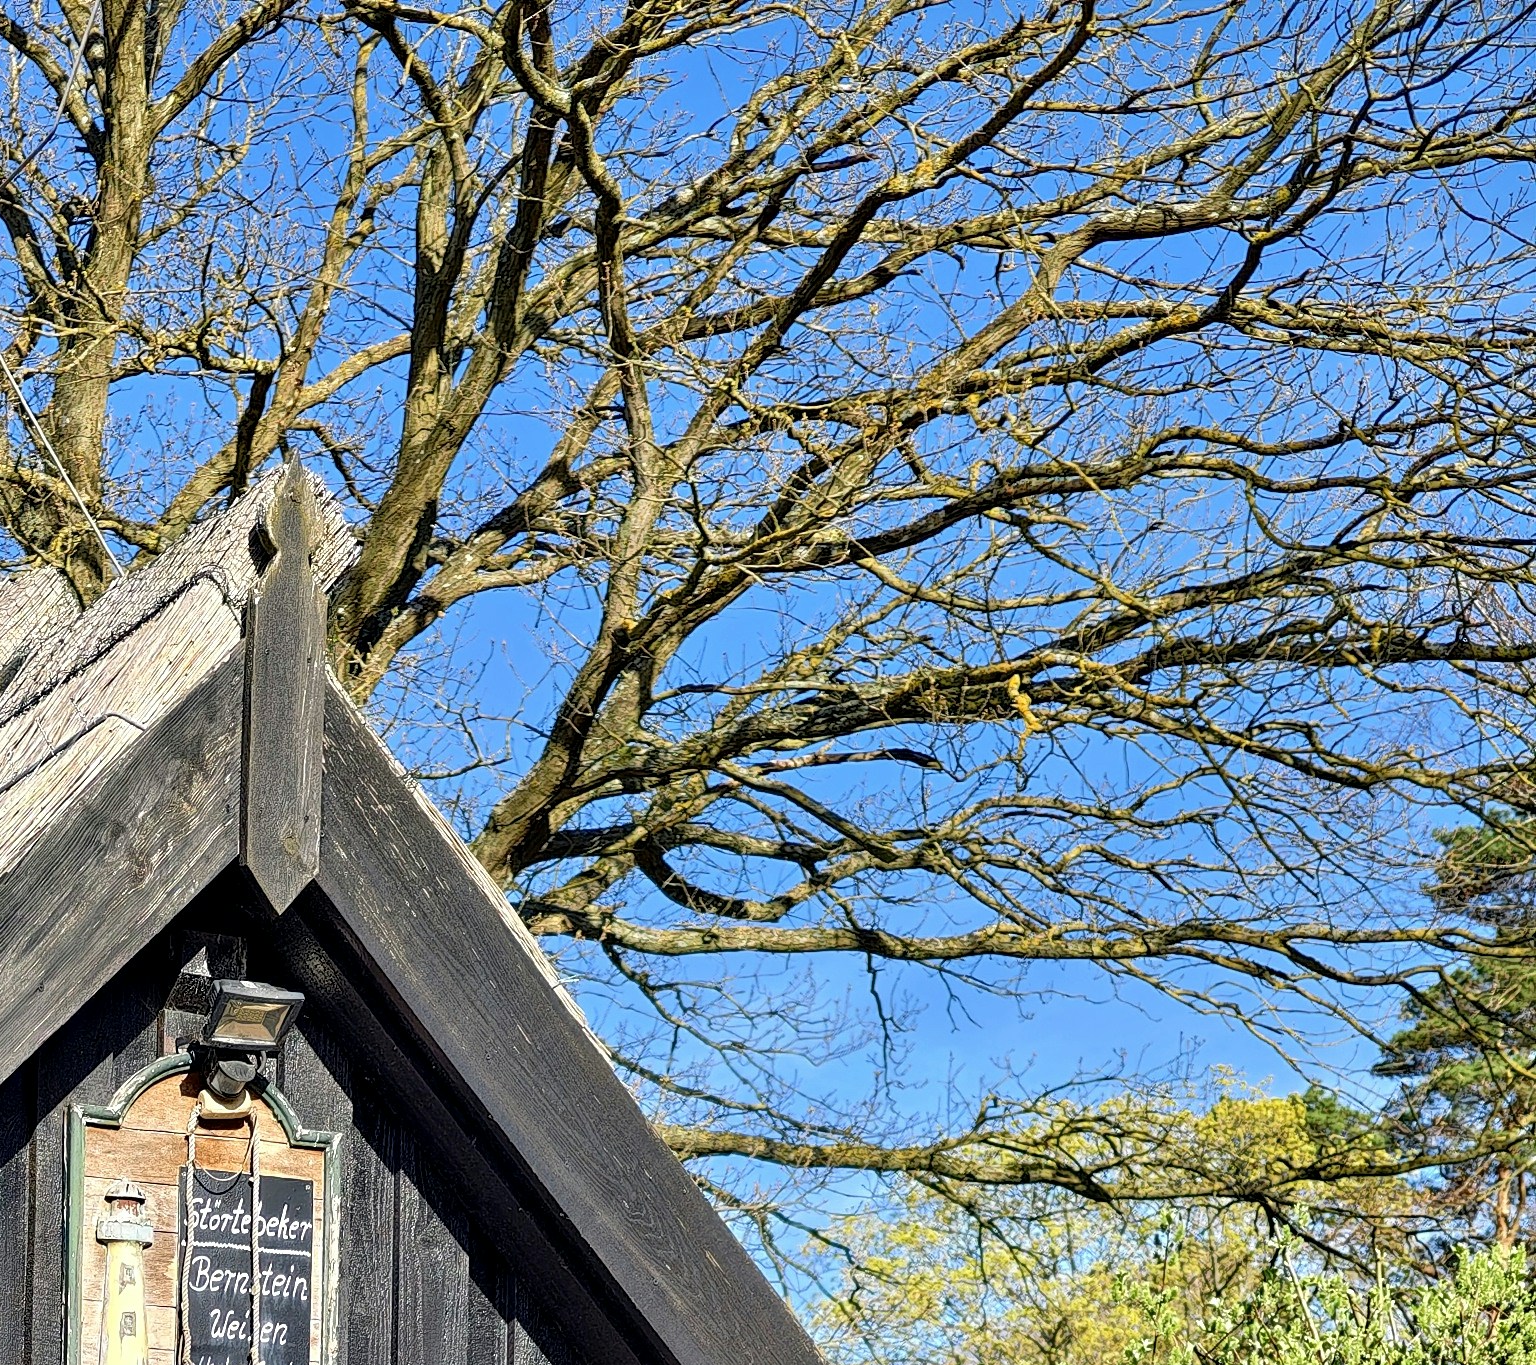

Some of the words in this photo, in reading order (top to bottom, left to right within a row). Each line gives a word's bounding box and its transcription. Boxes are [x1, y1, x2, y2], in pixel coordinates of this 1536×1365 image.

[184, 1197, 312, 1241] Störtebeker
[189, 1255, 308, 1301] Berntein
[209, 1308, 288, 1345] Weien
